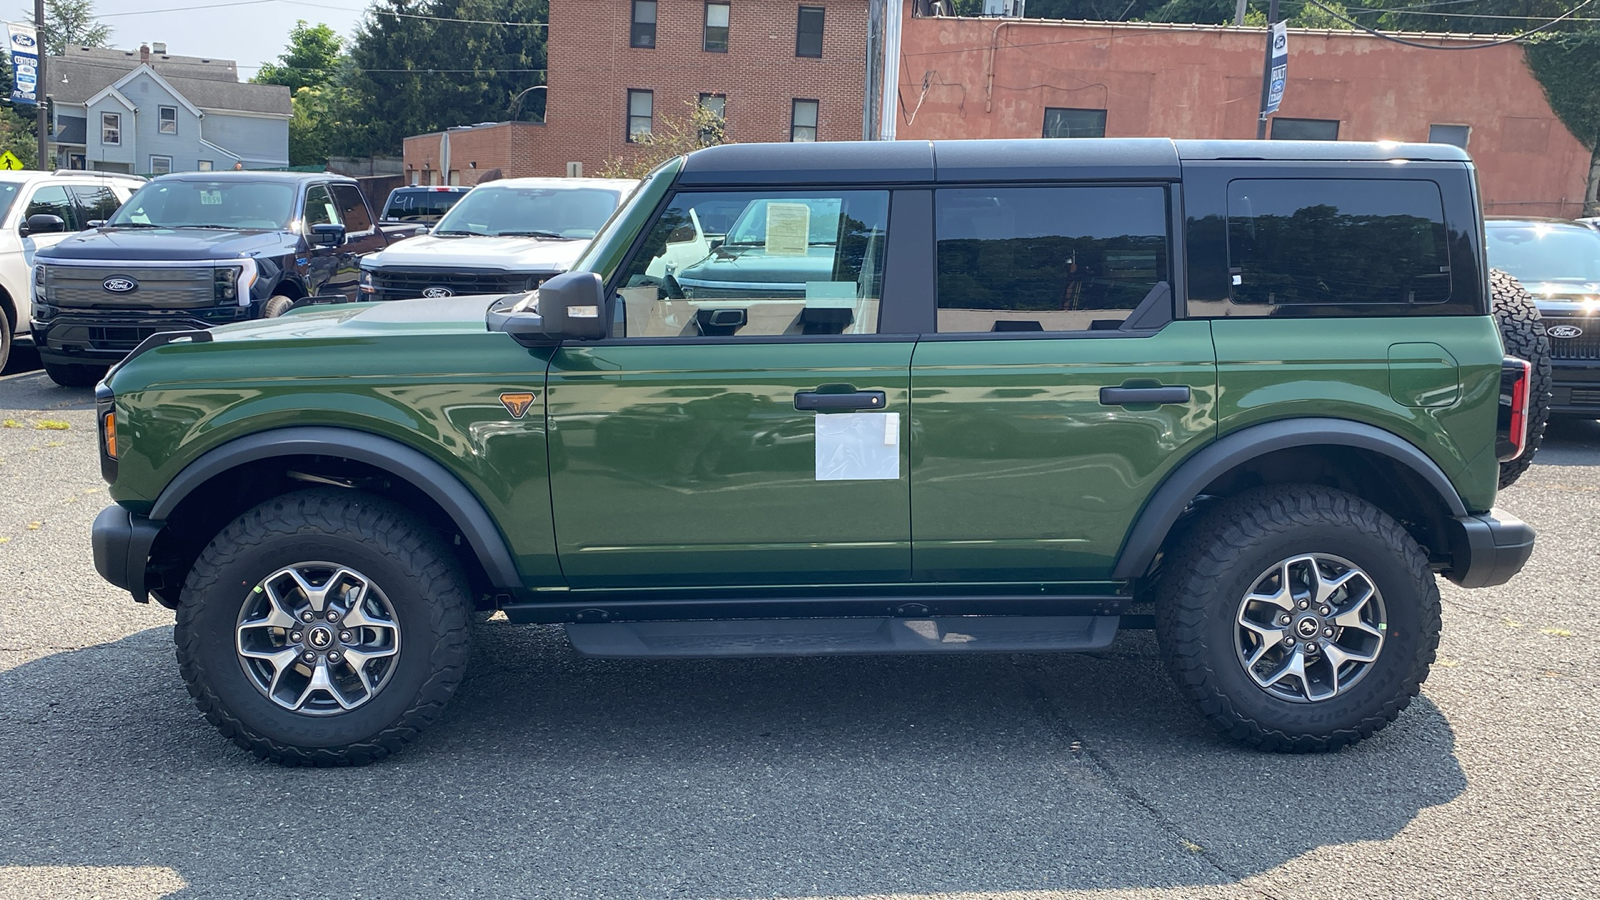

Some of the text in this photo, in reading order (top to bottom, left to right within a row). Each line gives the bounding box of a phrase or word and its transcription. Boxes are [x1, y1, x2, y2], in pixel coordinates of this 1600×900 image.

[14, 56, 37, 67] CERTIFIED
[202, 195, 221, 204] 9859
[394, 195, 414, 212] 41
[427, 288, 447, 299] Ford
[1553, 326, 1577, 336] Ford
